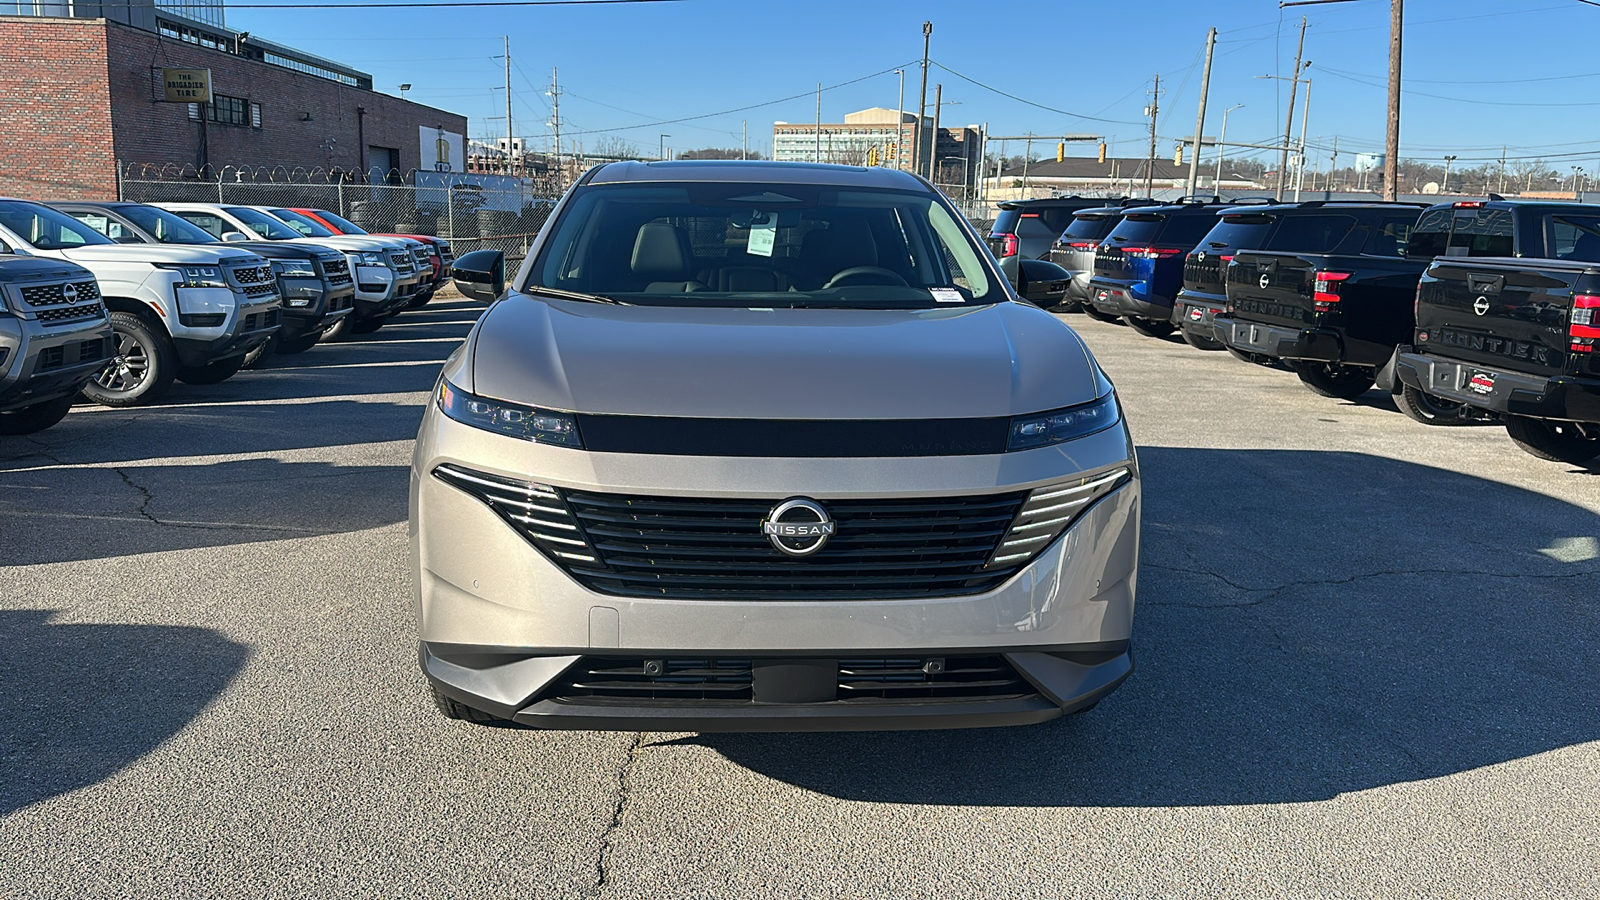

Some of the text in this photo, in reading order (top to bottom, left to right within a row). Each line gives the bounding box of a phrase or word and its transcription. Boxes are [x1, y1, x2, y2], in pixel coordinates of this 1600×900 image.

[1234, 298, 1304, 319] FRONTIER
[1431, 329, 1548, 362] FRONTIER
[767, 524, 832, 535] NISSAN
